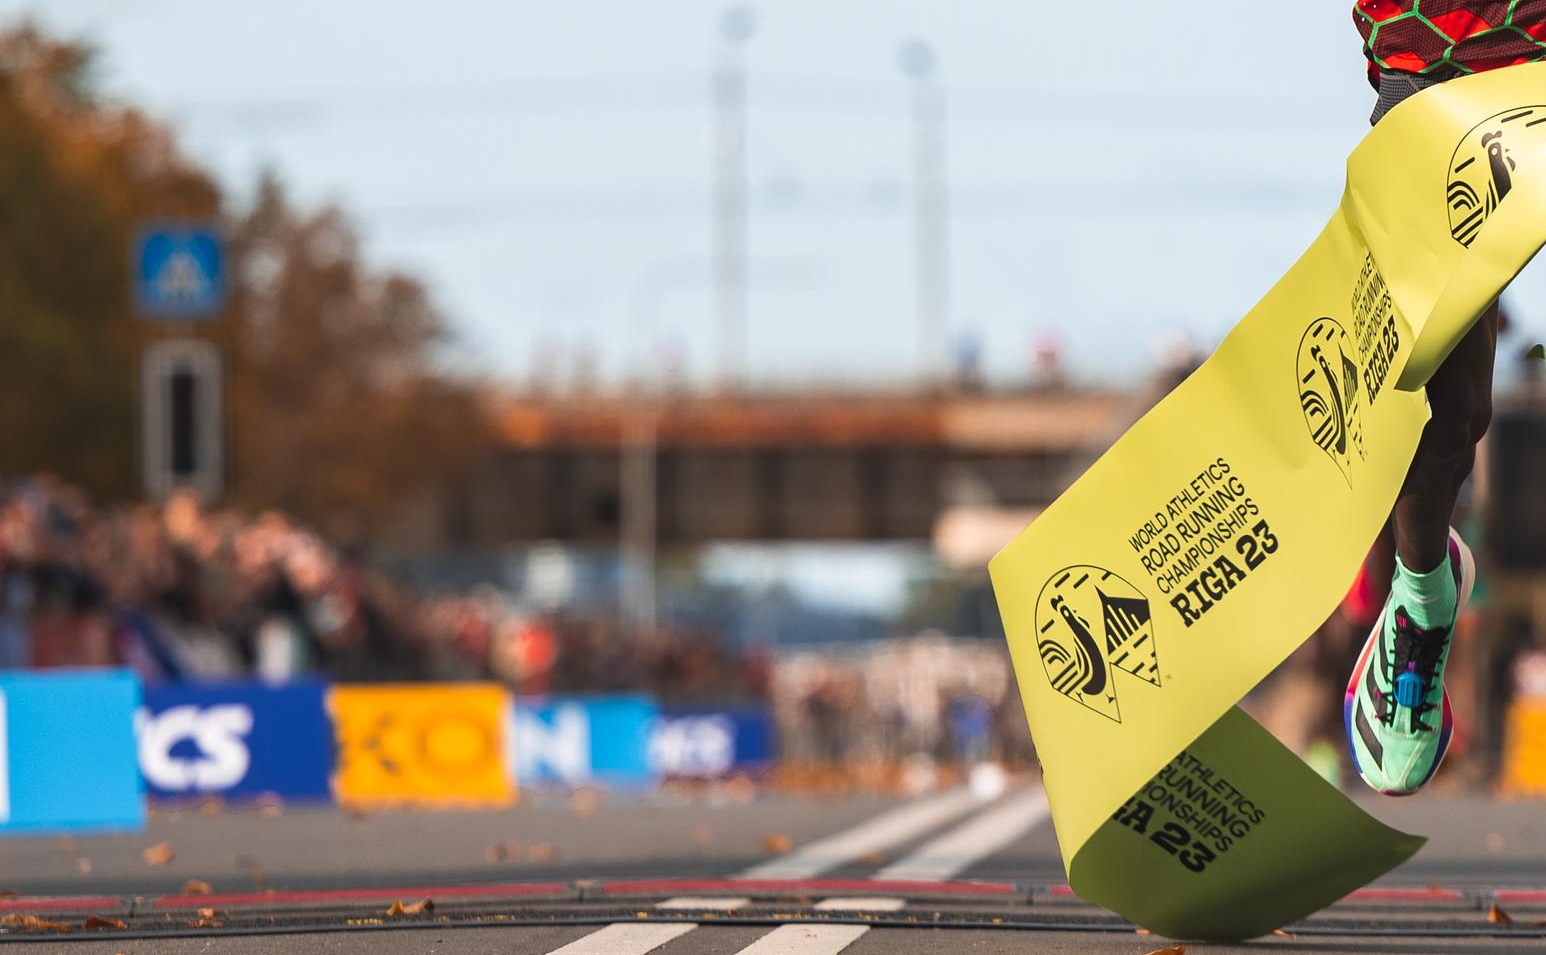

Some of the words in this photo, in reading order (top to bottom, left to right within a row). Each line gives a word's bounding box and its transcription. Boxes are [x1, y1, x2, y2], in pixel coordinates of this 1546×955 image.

[1363, 341, 1389, 406] RIGA
[1382, 314, 1399, 364] 23
[1128, 512, 1169, 553] WORLD
[1166, 457, 1231, 521] ATHLETICS
[1140, 533, 1181, 576] ROAD
[1175, 476, 1245, 543] RUNNING
[1156, 498, 1259, 594] CHAMPIONSHIPS
[1169, 554, 1247, 628] RIGA
[1235, 518, 1279, 572] 23
[1175, 750, 1266, 824] ATHLETICS
[1150, 821, 1217, 873] 23
